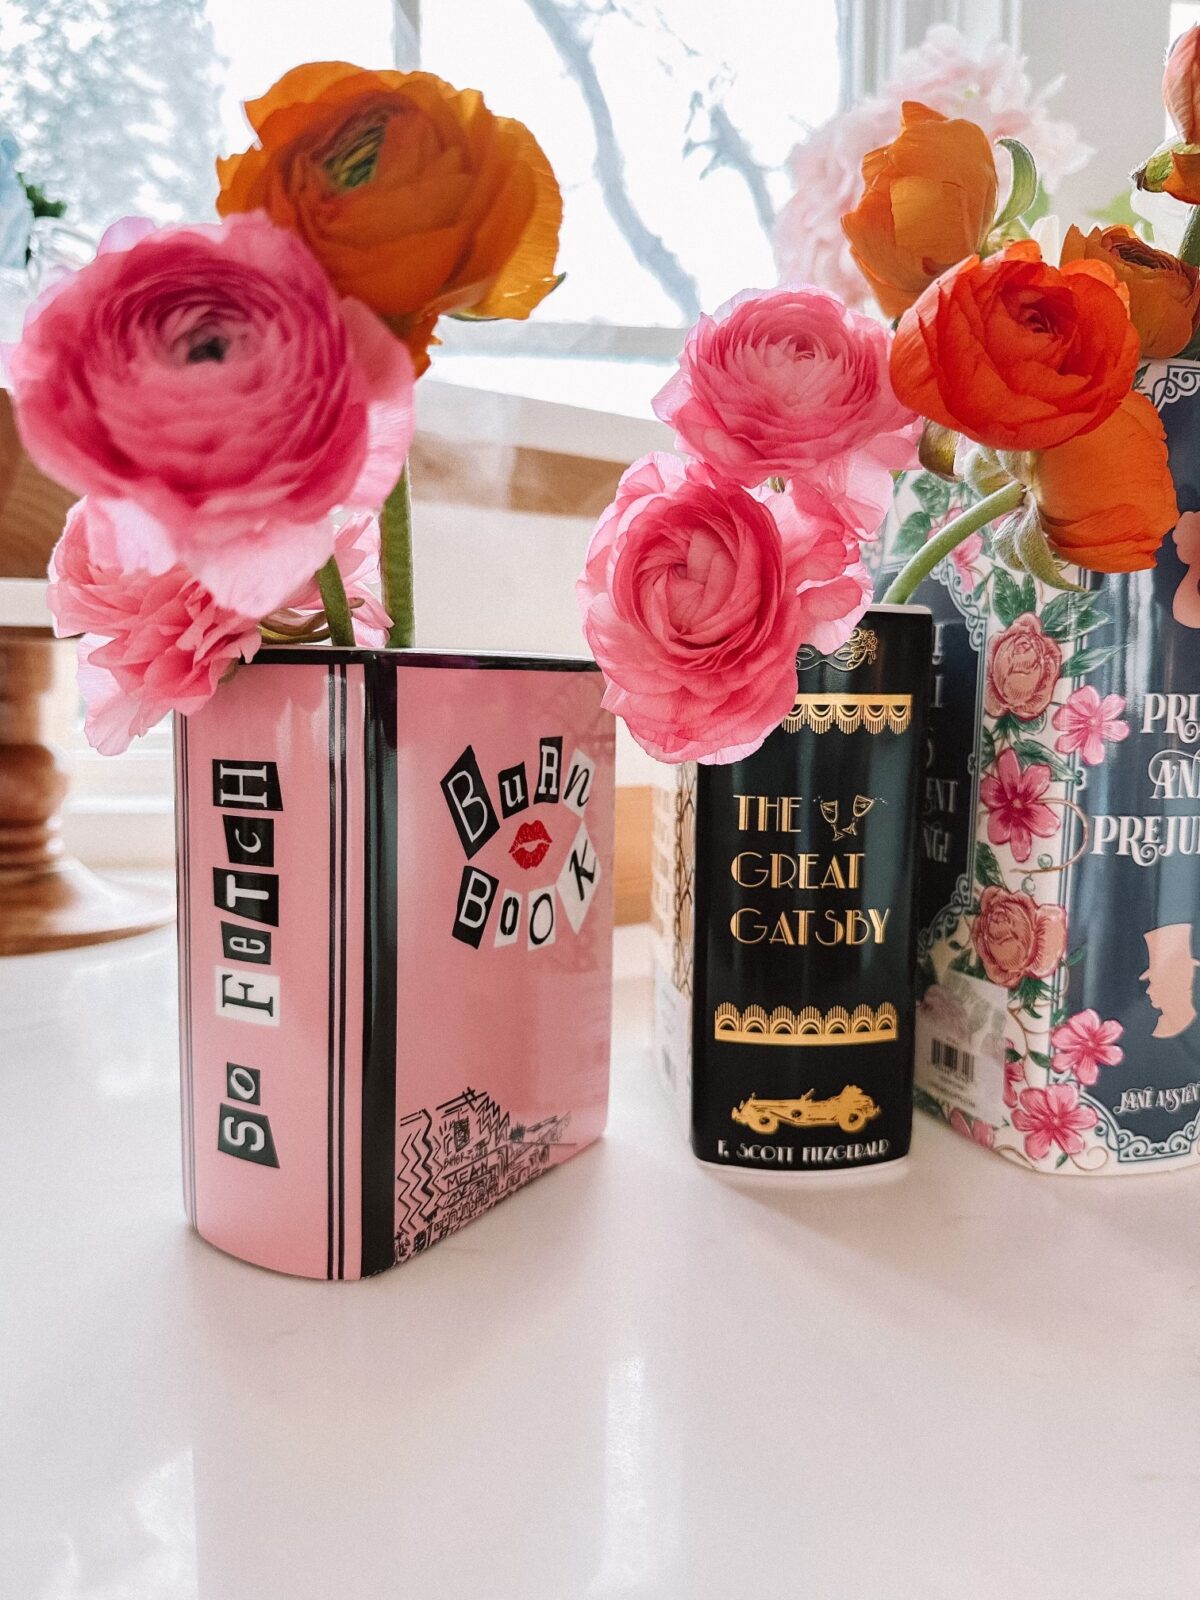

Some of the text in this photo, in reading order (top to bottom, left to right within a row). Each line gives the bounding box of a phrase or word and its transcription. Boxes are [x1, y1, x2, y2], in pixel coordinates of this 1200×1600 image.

[1140, 693, 1200, 743] PRI
[1148, 749, 1200, 800] AN
[733, 795, 802, 833] THE
[1090, 815, 1200, 867] PREJU
[731, 852, 866, 889] GREAT
[730, 907, 892, 946] GATSBY
[1113, 1081, 1200, 1114] JANE AUSTEN
[717, 1138, 889, 1163] F. SCOTT FITZGERALD
[447, 1156, 489, 1193] MEAN
